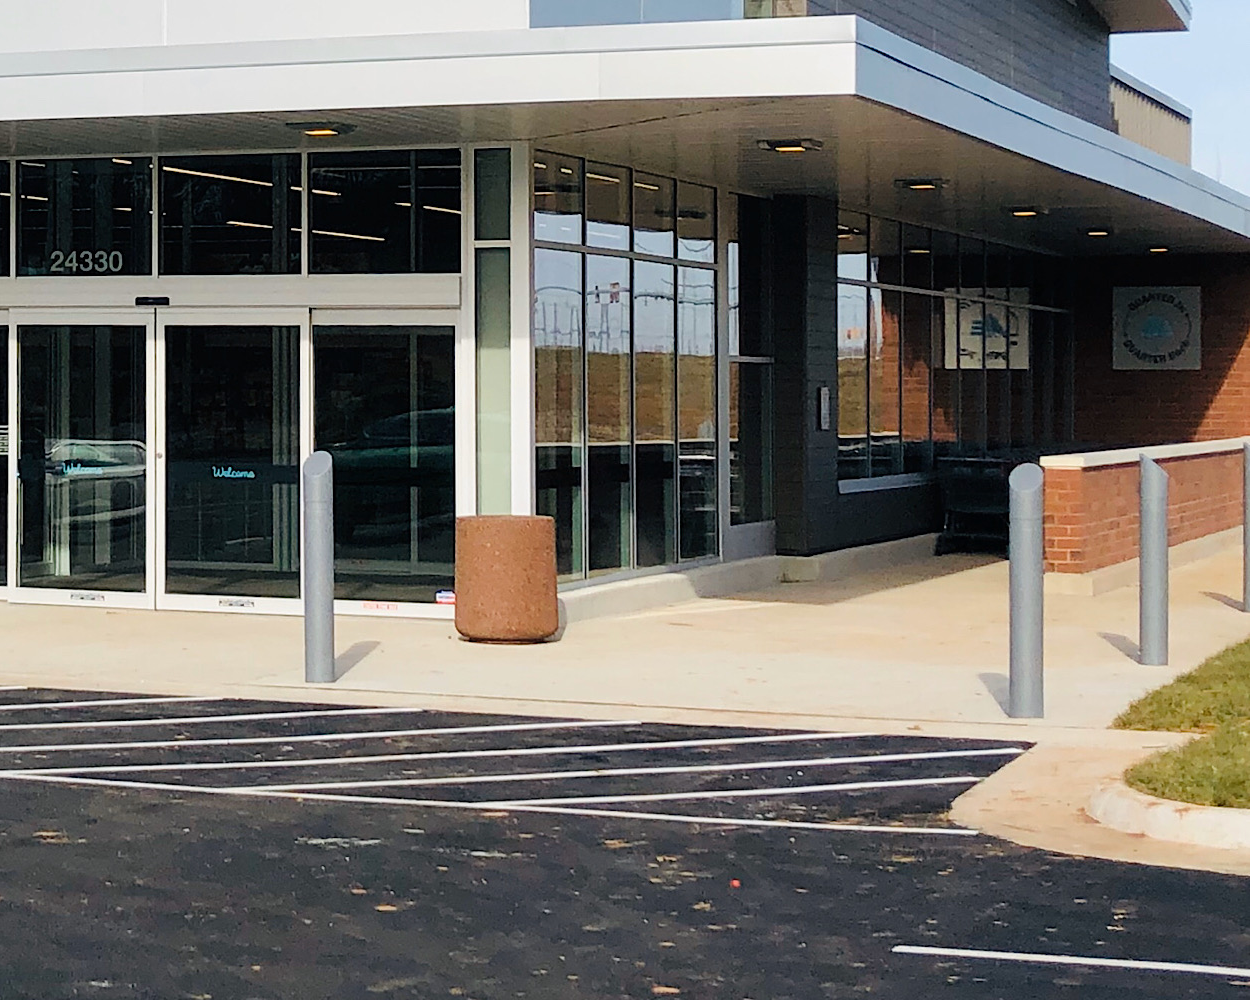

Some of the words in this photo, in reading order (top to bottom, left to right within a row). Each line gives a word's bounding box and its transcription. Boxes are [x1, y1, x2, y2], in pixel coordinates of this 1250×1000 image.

[50, 250, 123, 272] 24330
[62, 463, 104, 476] Welcome
[211, 465, 256, 479] Welcome
